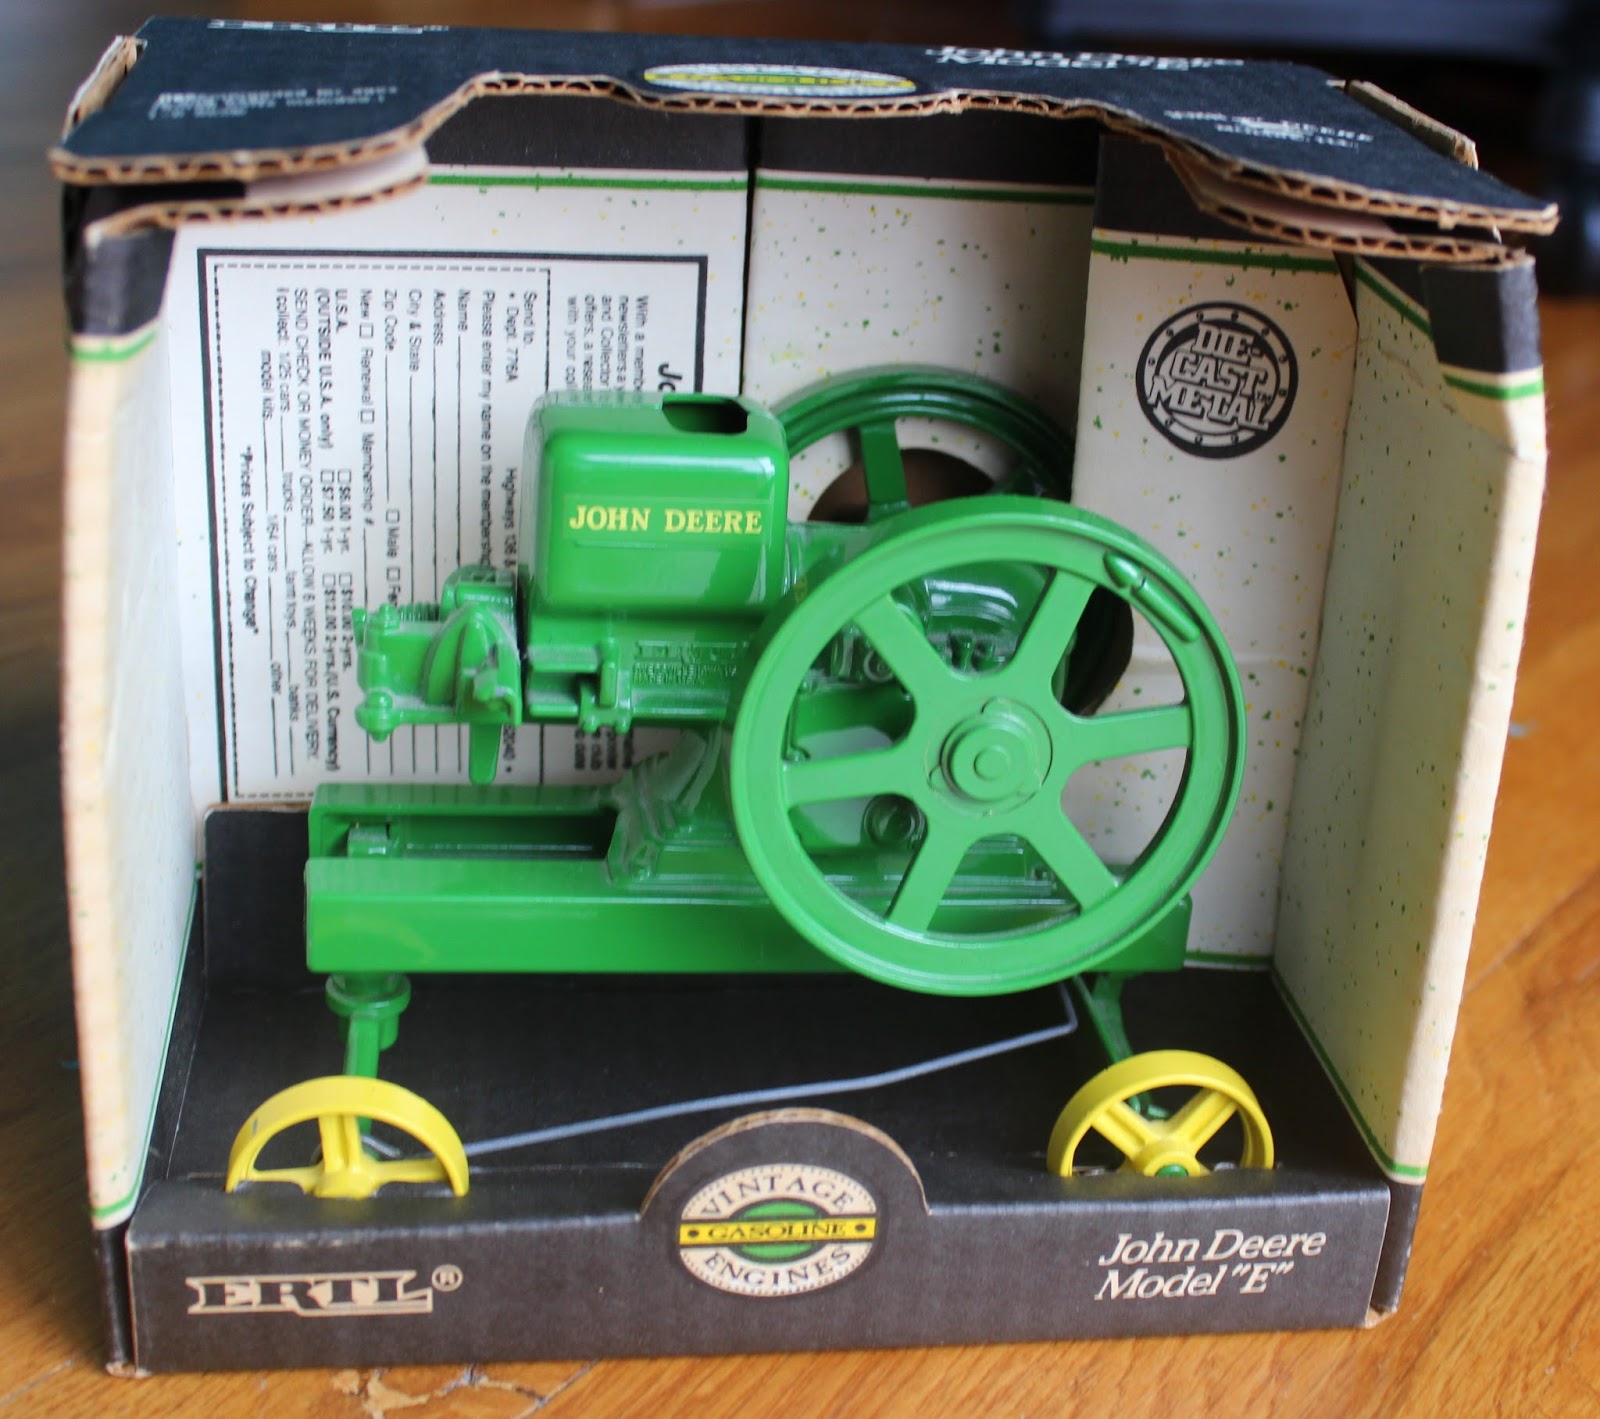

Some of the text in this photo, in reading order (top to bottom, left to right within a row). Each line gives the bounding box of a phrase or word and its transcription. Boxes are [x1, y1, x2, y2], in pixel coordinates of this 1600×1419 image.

[294, 288, 309, 331] SEND
[360, 288, 373, 319] New
[382, 288, 398, 352] Zip Code
[407, 288, 423, 316] City
[433, 289, 446, 347] Address
[458, 289, 471, 332] Name
[482, 291, 496, 337] Please
[523, 291, 538, 326] Send
[315, 288, 332, 361] (OUTSIDE
[600, 295, 614, 387] and Collector
[296, 335, 310, 387] CHECK
[409, 335, 423, 372] State
[481, 341, 493, 376] enter
[564, 330, 576, 361] your
[261, 350, 275, 393] model
[360, 347, 374, 406] Renewal
[478, 380, 492, 399] my
[1170, 350, 1268, 397] CAST
[279, 383, 292, 413] cars
[297, 390, 311, 413] OR
[1147, 375, 1270, 431] METAL
[317, 413, 334, 449] only)
[481, 404, 492, 440] name
[298, 418, 312, 472] MONEY
[480, 444, 492, 461] on
[361, 433, 375, 512] Membership
[480, 464, 494, 486] the
[502, 467, 518, 530] Highways
[240, 502, 255, 554] Subject
[569, 504, 763, 534] JOHN DEERE
[267, 545, 278, 573] cars
[387, 527, 400, 558] Male
[243, 558, 256, 572] to
[284, 602, 298, 629] toys
[303, 606, 318, 656] WEEKS
[270, 662, 283, 696] other
[305, 659, 318, 688] FOR
[288, 684, 300, 723] banks
[702, 1175, 854, 1214] VINTAGE
[708, 1223, 847, 1241] GASOLINE
[1098, 1228, 1327, 1266] John Deere
[704, 1245, 851, 1286] ENGINES
[1094, 1260, 1295, 1300] Model "E"
